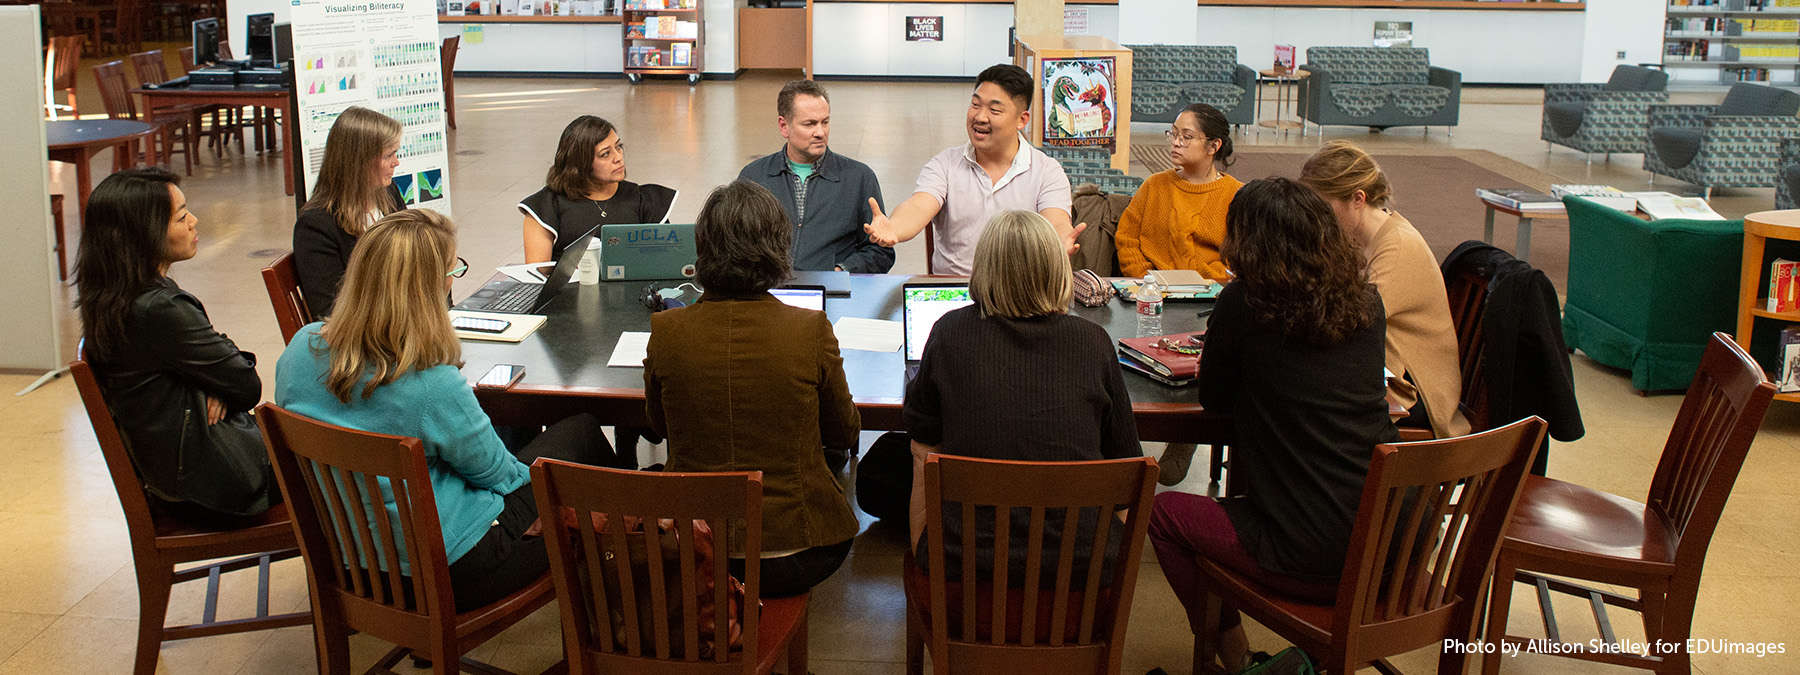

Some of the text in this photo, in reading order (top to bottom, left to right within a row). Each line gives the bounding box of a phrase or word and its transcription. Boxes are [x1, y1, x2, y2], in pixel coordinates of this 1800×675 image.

[325, 2, 405, 13] Visualizing Biliteracy
[1388, 22, 1399, 30] NO
[909, 30, 940, 38] MATTER
[1070, 137, 1110, 146] TOGETHER
[627, 228, 680, 243] UCLA
